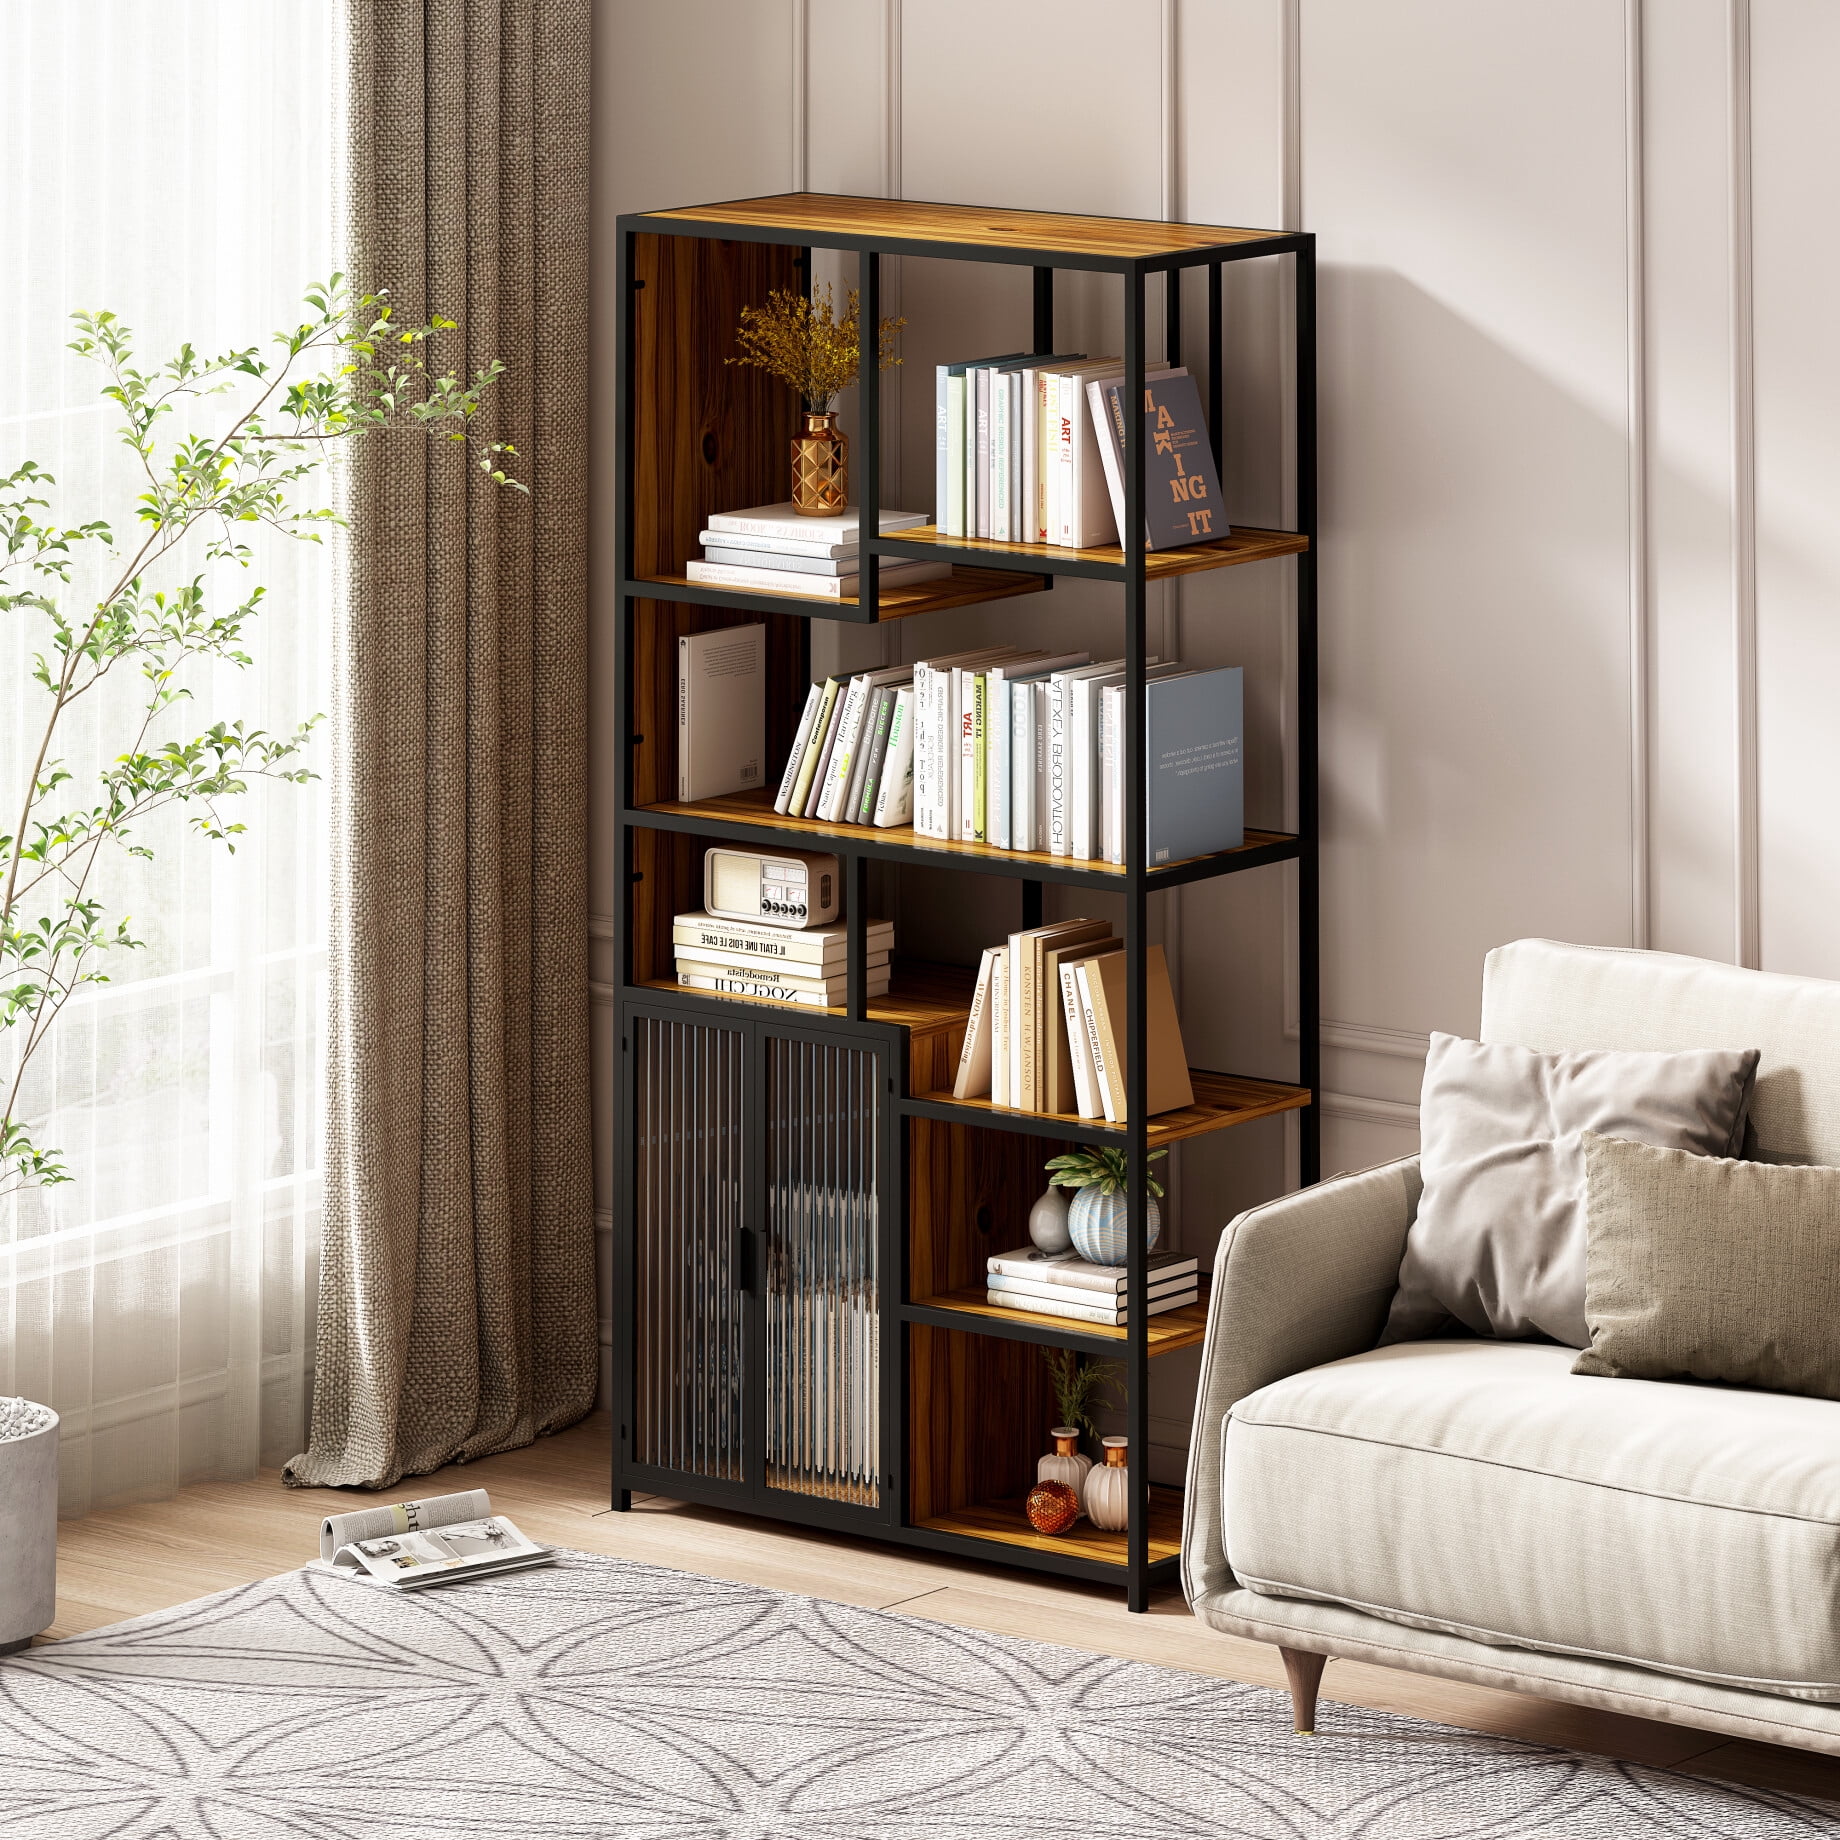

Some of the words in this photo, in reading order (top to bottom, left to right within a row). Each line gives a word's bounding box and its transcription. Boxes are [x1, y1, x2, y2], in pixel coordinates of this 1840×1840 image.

[937, 406, 947, 432] ART
[978, 409, 988, 436] ART
[1062, 417, 1071, 444] ART
[1110, 395, 1124, 438] MAKING
[1187, 509, 1213, 536] IT
[838, 690, 859, 744] Harrisburg
[864, 698, 879, 745] Brisbane
[888, 704, 905, 748] Houston
[780, 742, 802, 797] WASHINGTON
[862, 779, 876, 814] FORMULA
[877, 700, 889, 736] SUCCESS
[971, 982, 985, 1018] AVEDON
[1063, 973, 1075, 1021] CHANEL
[961, 1019, 978, 1064] advertising
[1023, 1024, 1032, 1091] H.W.JANSON
[1085, 1008, 1104, 1073] CHIPPERFIELD
